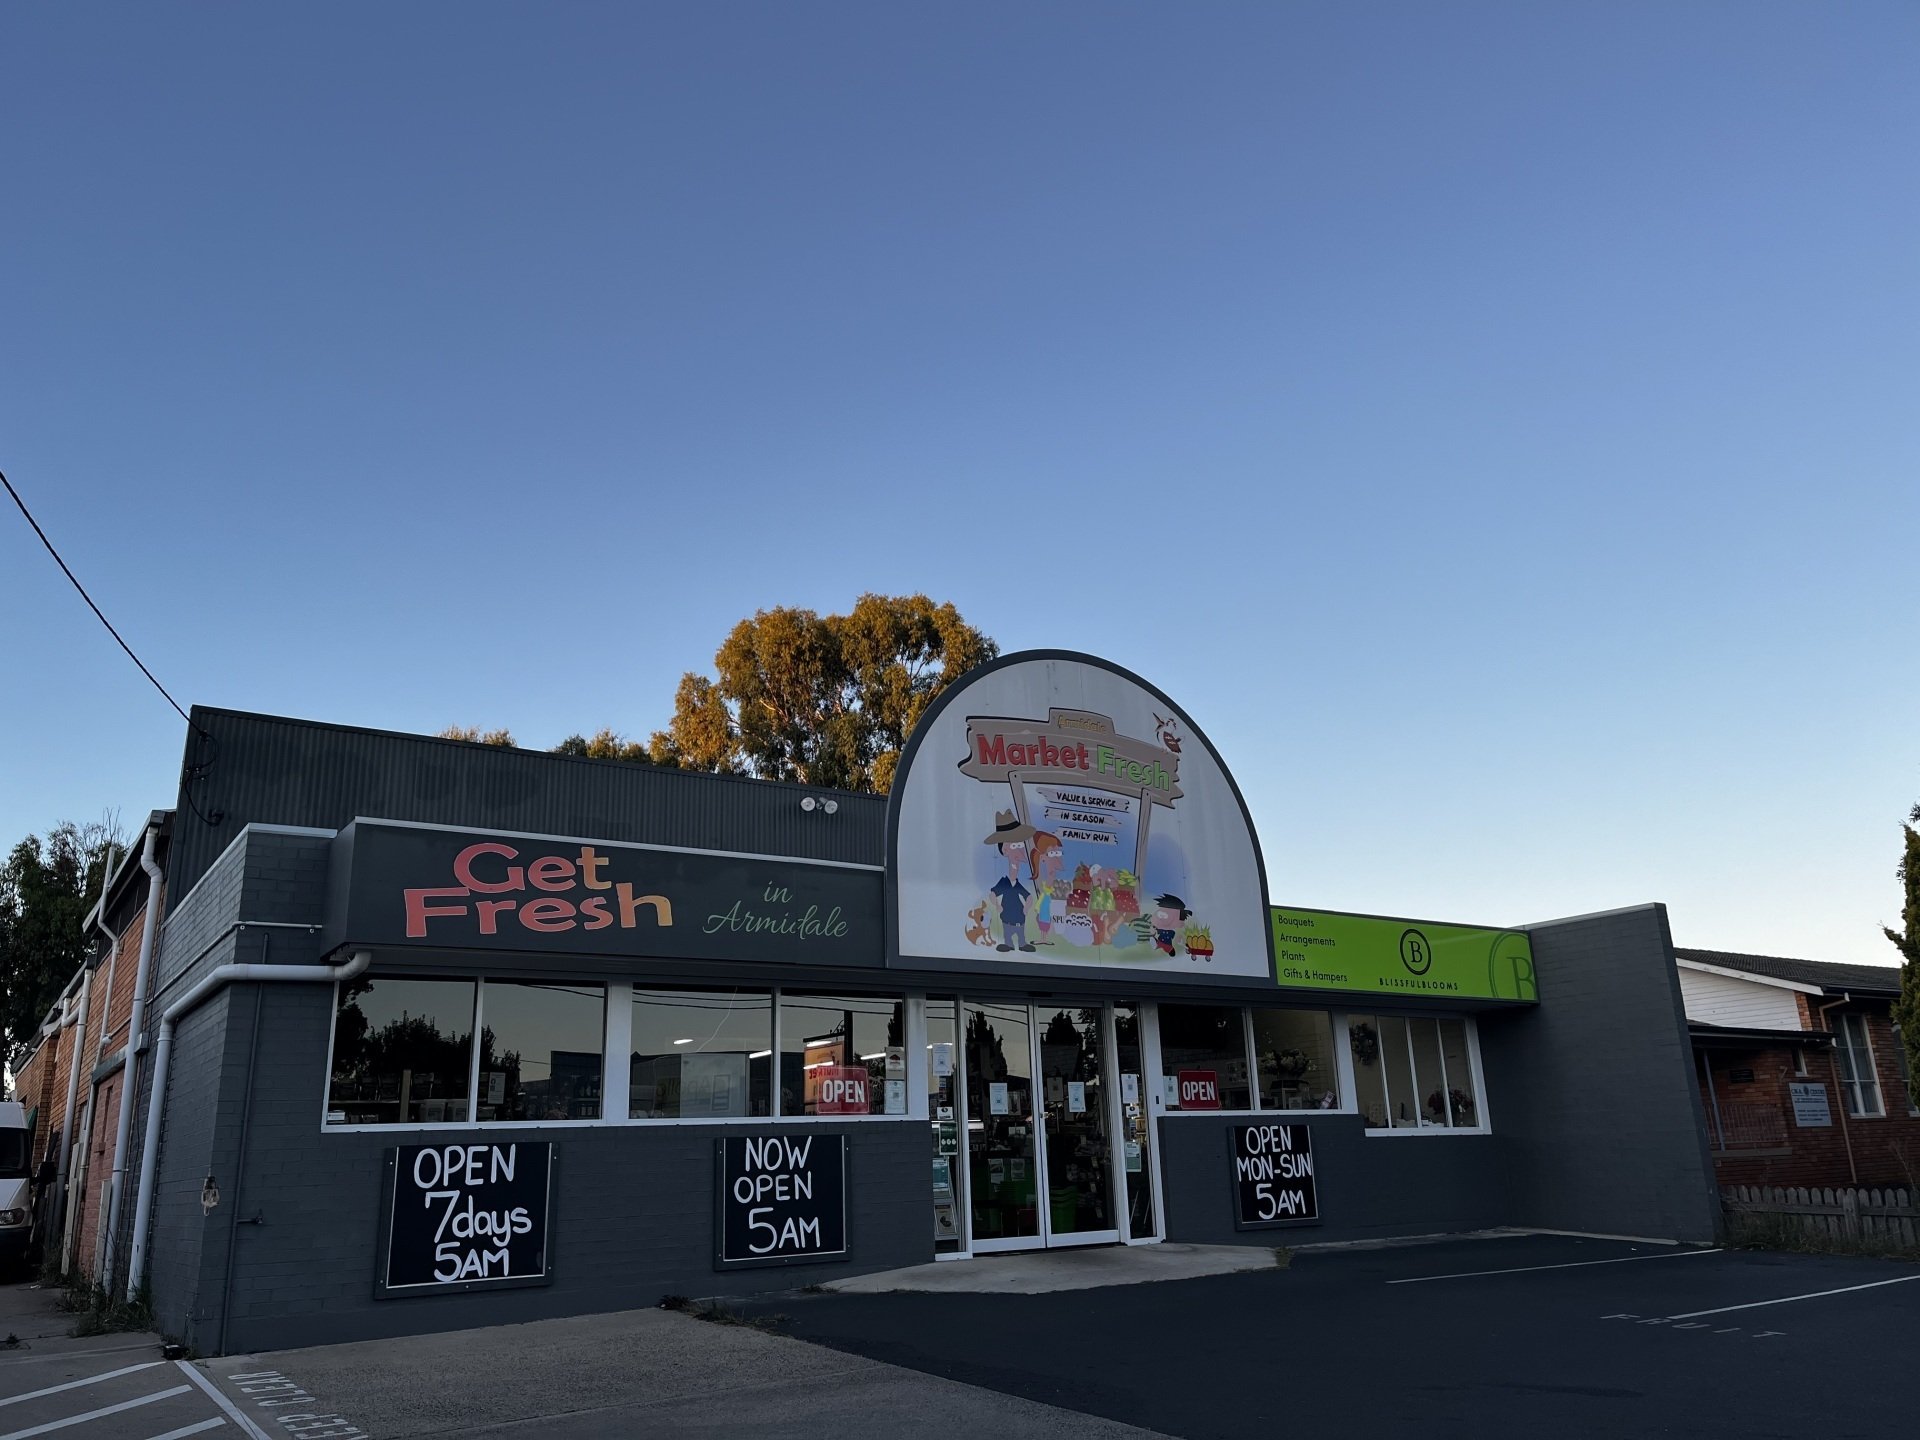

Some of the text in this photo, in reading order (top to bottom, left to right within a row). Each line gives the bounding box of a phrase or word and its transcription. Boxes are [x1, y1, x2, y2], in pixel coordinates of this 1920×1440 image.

[976, 734, 1170, 791] Market Fresh
[1072, 813, 1105, 824] SEASON
[1093, 831, 1110, 842] RUN
[453, 842, 612, 894] Get
[763, 880, 793, 904] in
[403, 882, 673, 938] Fresh
[702, 900, 849, 941] Armidale
[1278, 914, 1315, 928] Bouquets
[1280, 932, 1336, 947] Arrangements
[1409, 940, 1423, 963] B
[1281, 950, 1306, 962] Plants
[1283, 968, 1348, 983] Gifts & Hampers
[1379, 978, 1459, 991] BLISSFULBLOOMS
[822, 1079, 865, 1103] OPEN
[1182, 1080, 1216, 1101] OPEN
[1246, 1125, 1292, 1155] OPEN
[413, 1143, 517, 1189] OPEN
[745, 1135, 813, 1172] NOW
[1236, 1152, 1312, 1182] MON-SUN
[733, 1170, 812, 1204] OPEN
[433, 1241, 510, 1282] 5AM
[1599, 1313, 1788, 1338] FRUIT
[227, 1369, 369, 1440] EEP CLEAR
